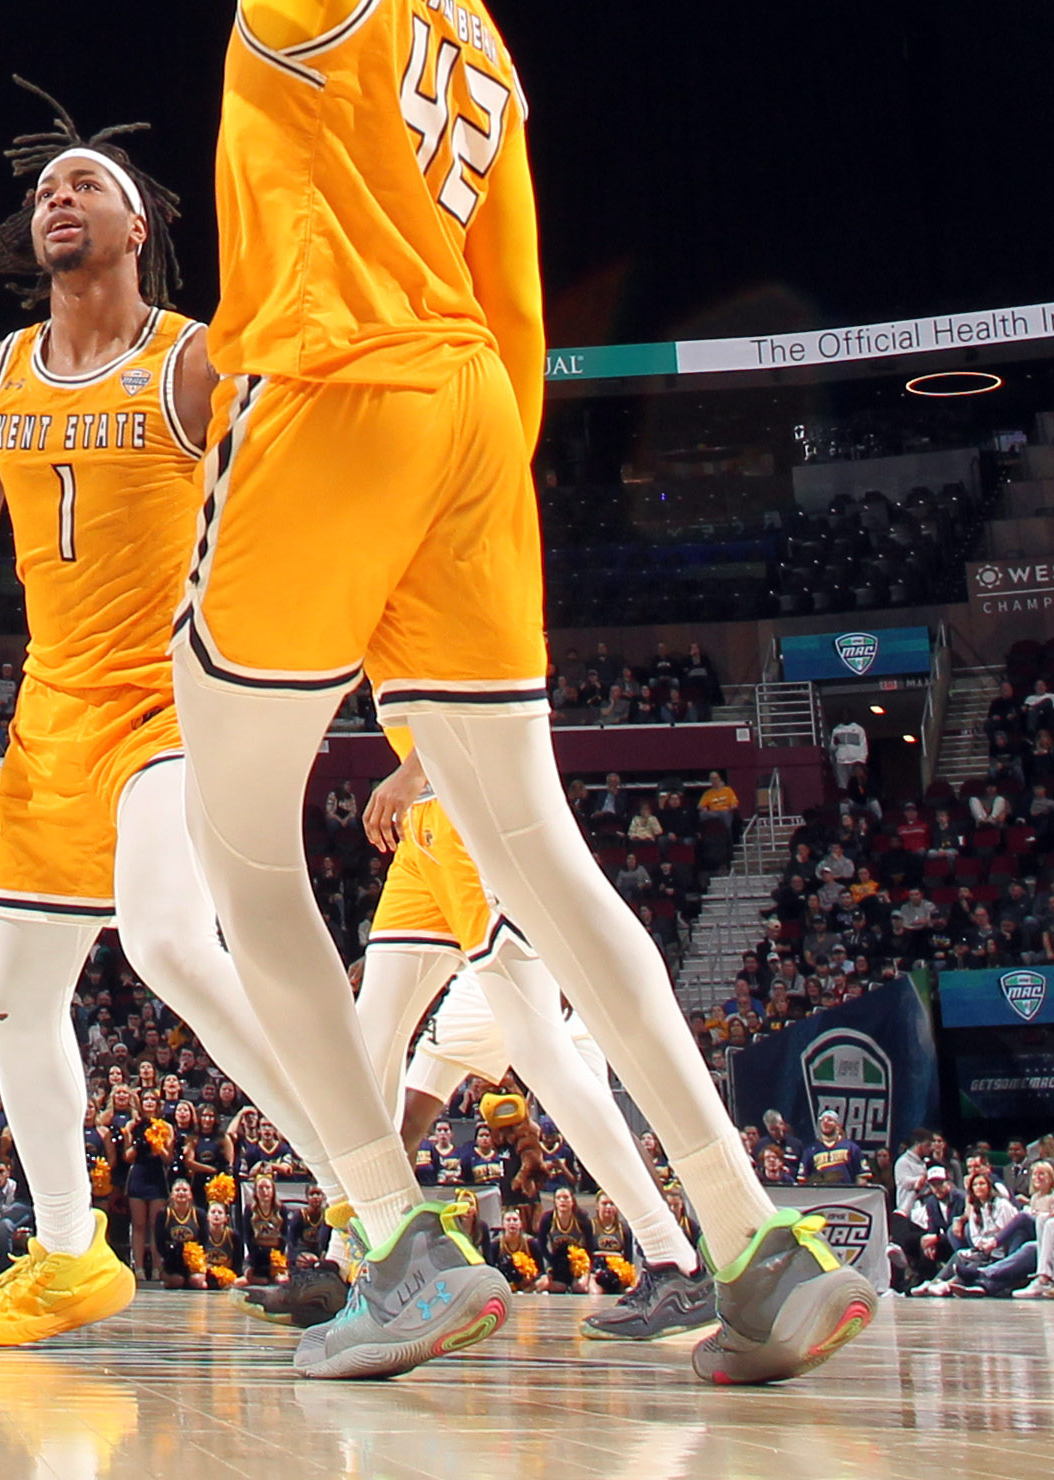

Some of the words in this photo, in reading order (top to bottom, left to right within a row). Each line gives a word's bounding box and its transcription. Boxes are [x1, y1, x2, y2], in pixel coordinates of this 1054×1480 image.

[399, 13, 512, 229] 42
[750, 339, 805, 364] The
[818, 322, 920, 358] Official
[933, 310, 1028, 344] Health
[63, 412, 147, 449] STATE
[50, 463, 77, 562] 1
[842, 646, 874, 658] MAC
[1008, 986, 1043, 998] MAC
